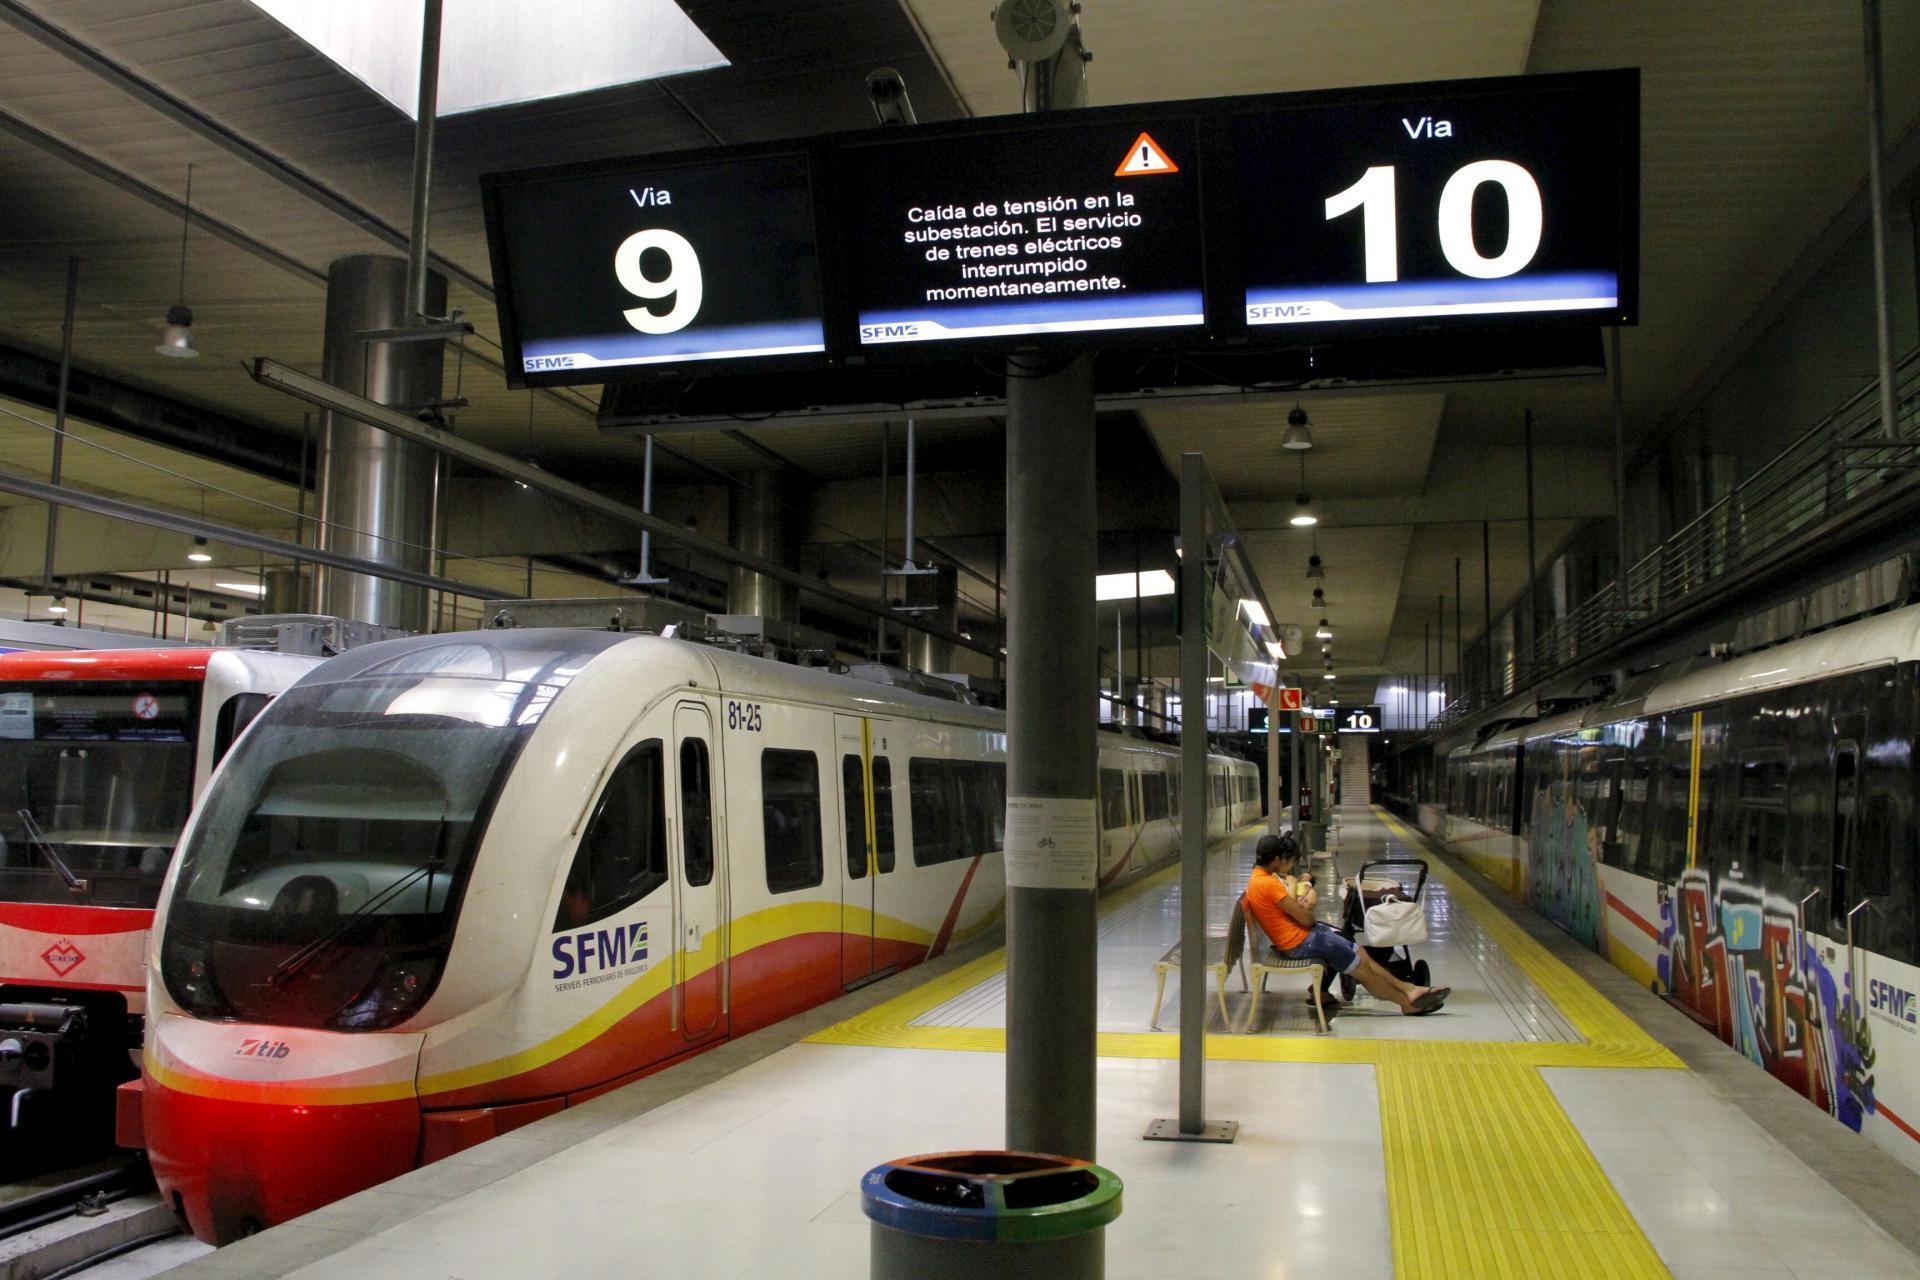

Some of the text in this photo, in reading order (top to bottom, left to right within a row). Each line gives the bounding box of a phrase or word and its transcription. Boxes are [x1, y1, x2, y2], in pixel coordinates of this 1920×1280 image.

[1402, 117, 1452, 139] Via
[630, 187, 671, 207] Via
[908, 192, 1135, 222] Caída de tensión en la
[904, 212, 1142, 243] subestación. El servicio
[1325, 159, 1542, 283] 10
[925, 234, 1122, 262] de trenes eléctricos
[615, 228, 703, 334] 9
[962, 257, 1087, 279] interrumpido
[926, 275, 1127, 301] momentaneamente.
[862, 325, 904, 339] SFM
[525, 356, 562, 370] SFM
[728, 701, 762, 732] 81-25
[1347, 714, 1372, 728] 10
[552, 926, 627, 979] SFM
[555, 980, 582, 993] SERVEIS
[1870, 978, 1904, 1020] SFM
[258, 1040, 290, 1058] tib
